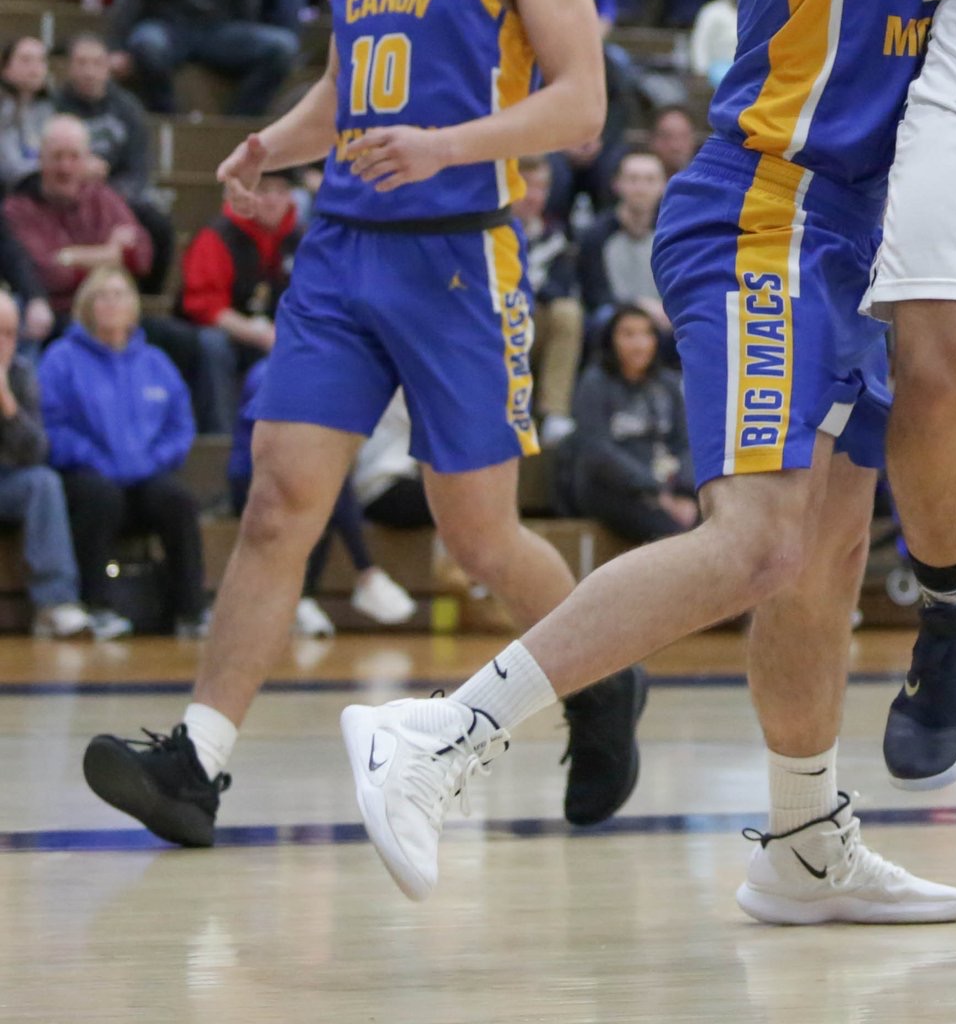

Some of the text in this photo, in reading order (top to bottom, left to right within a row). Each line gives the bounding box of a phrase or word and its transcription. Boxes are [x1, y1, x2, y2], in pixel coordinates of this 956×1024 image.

[350, 32, 412, 116] 10
[740, 271, 786, 449] BIG MACS
